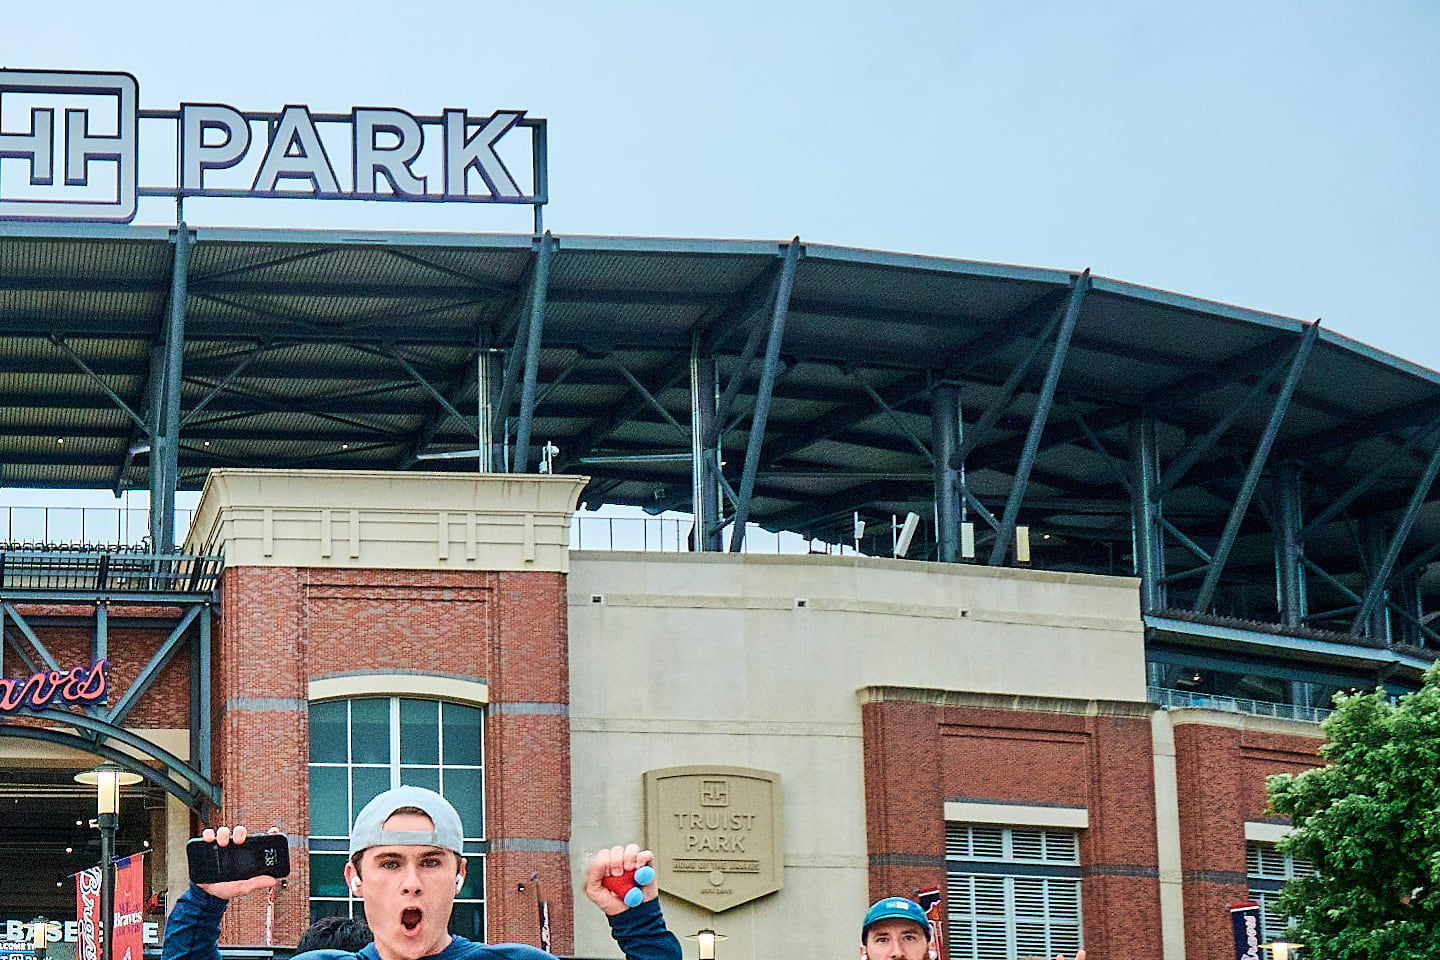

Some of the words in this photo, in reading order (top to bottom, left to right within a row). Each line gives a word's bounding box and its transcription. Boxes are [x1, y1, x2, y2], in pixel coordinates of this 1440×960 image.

[180, 103, 528, 199] PARK
[673, 813, 756, 831] TRUIST
[686, 836, 745, 853] PARK
[113, 912, 143, 928] Braves
